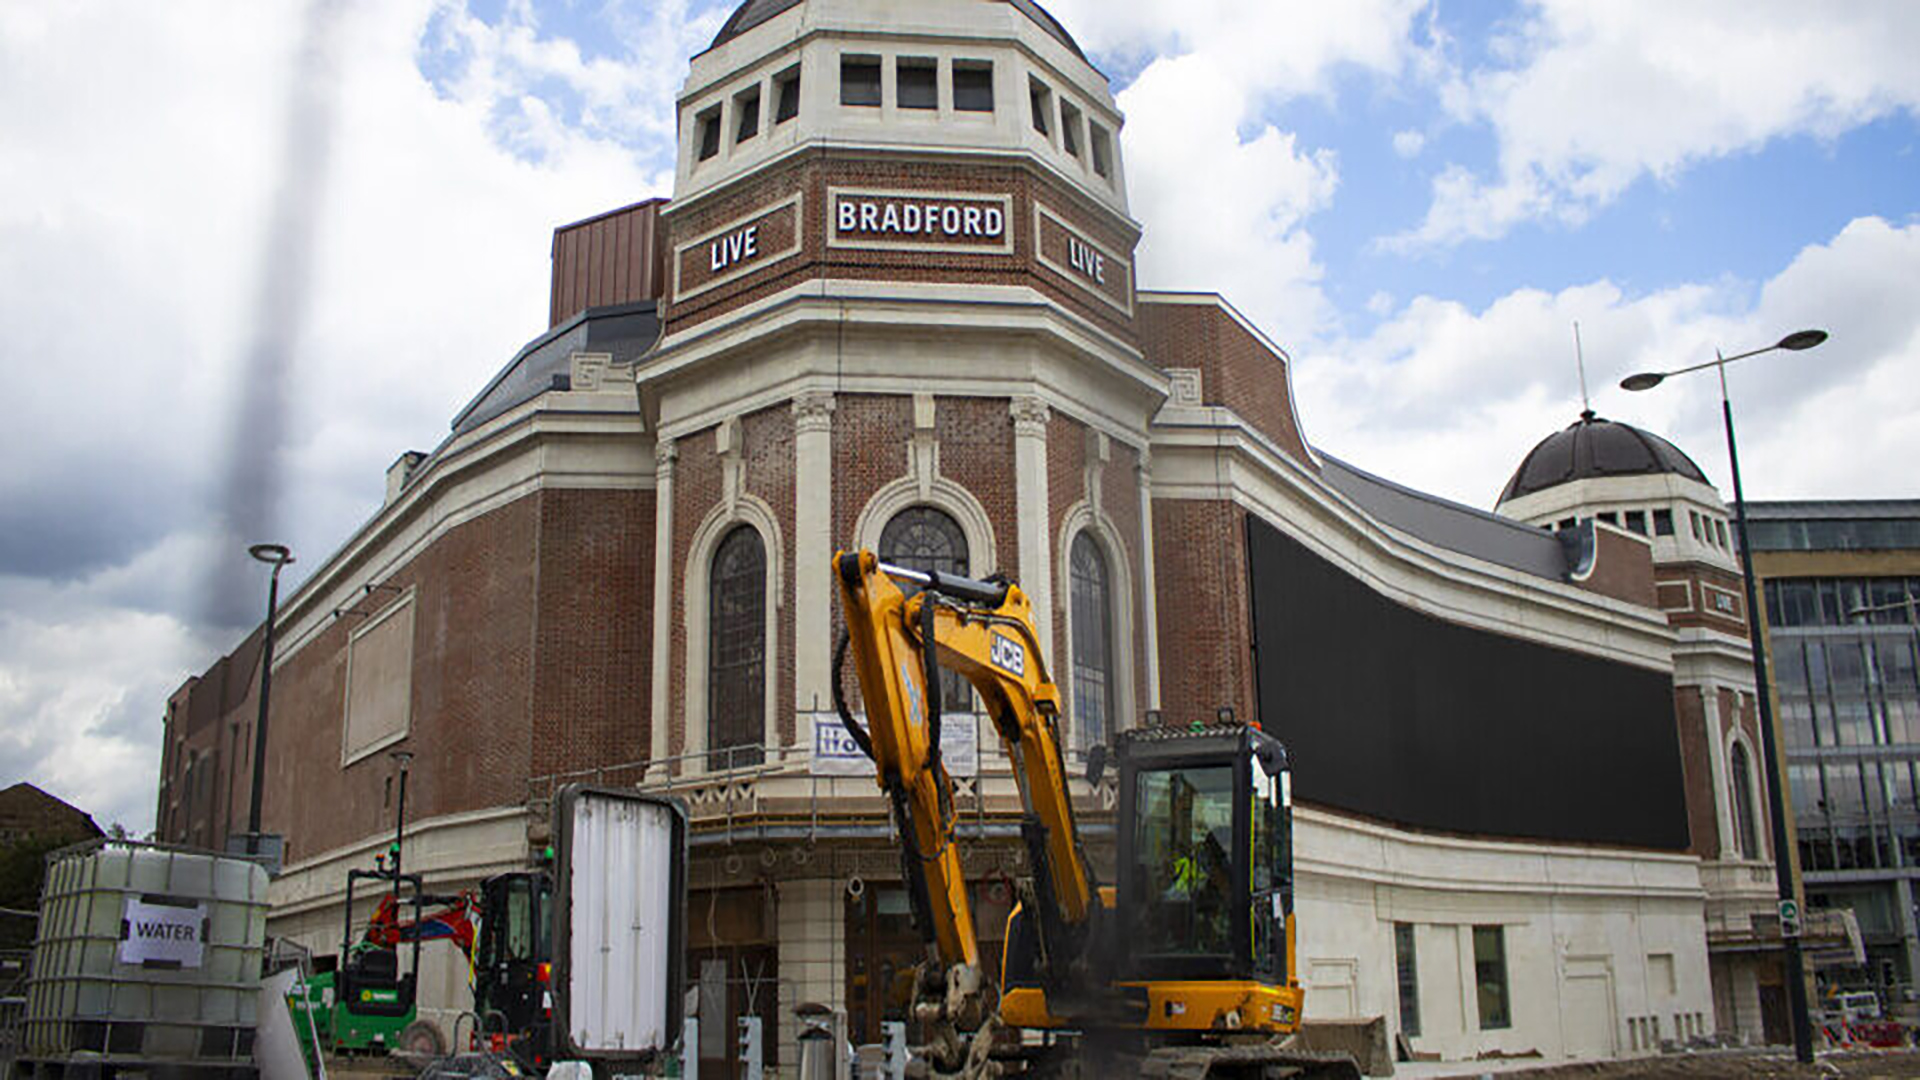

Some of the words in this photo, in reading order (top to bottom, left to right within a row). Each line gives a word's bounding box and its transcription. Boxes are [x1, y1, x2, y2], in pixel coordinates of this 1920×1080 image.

[838, 202, 1003, 236] BRADFORD
[711, 225, 758, 271] LIVE
[1069, 237, 1105, 285] LIVE
[991, 634, 1024, 675] JCB
[136, 921, 195, 941] WATER
